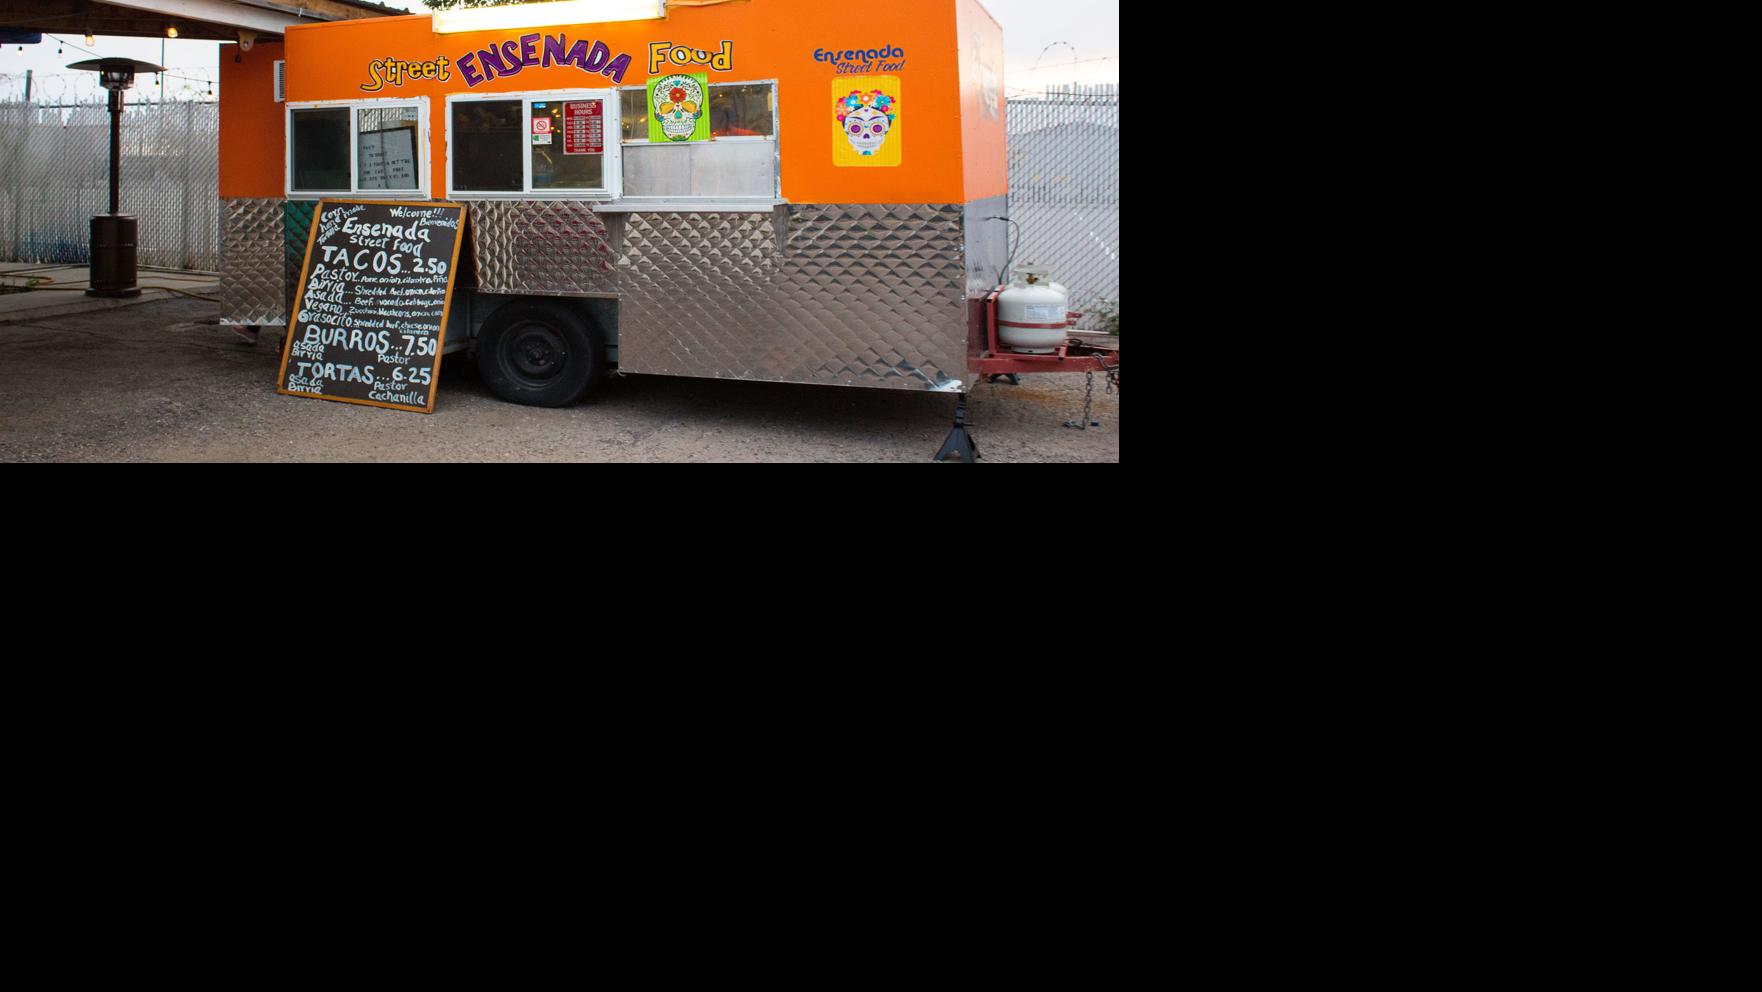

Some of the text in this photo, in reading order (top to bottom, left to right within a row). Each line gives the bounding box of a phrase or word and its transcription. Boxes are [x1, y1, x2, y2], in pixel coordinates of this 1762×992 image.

[360, 32, 733, 92] Street ENSENADA Food
[813, 43, 904, 65] Ensenada
[836, 59, 906, 74] Street Food
[341, 217, 431, 242] Ensenada
[412, 257, 447, 275] 2.50
[377, 352, 411, 365] Pastor
[373, 378, 408, 391] Pastor
[368, 390, 426, 405] Cachanilla
